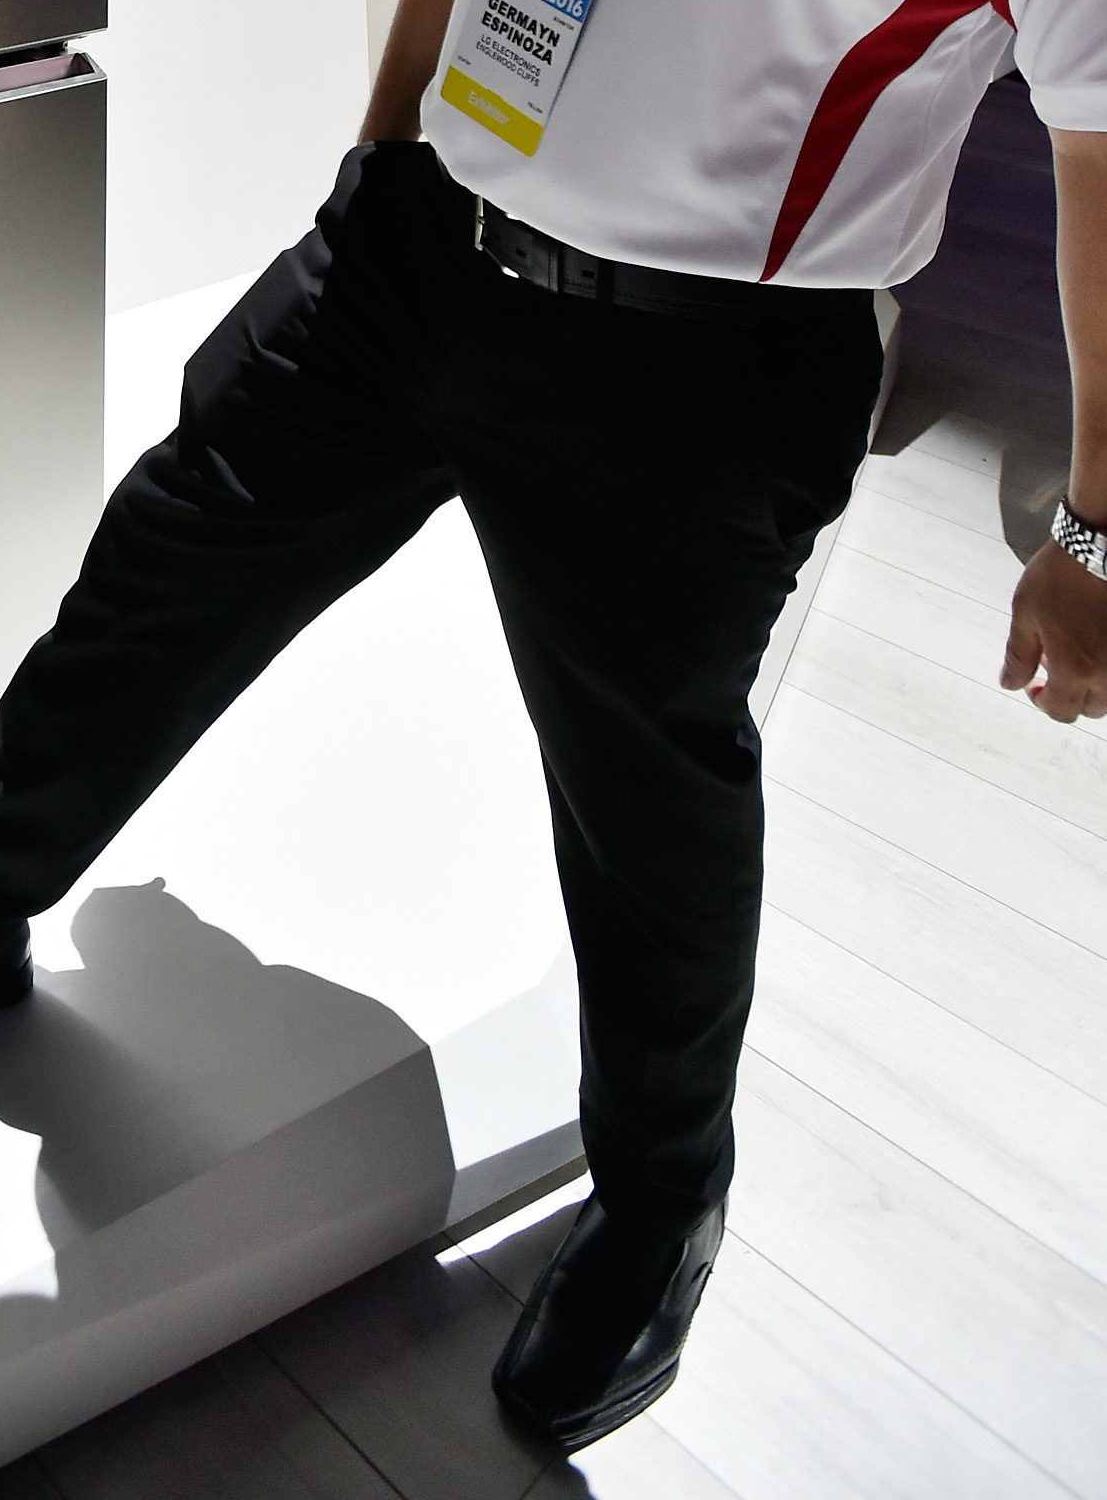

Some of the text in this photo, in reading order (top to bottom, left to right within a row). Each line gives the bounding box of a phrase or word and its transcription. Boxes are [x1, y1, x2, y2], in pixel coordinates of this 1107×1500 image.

[480, 34, 492, 46] LG
[491, 38, 542, 77] ELECTRONICS
[481, 11, 553, 66] ESPINOZA
[475, 41, 517, 73] ENGLEWOOD
[516, 67, 540, 87] CLIFFS
